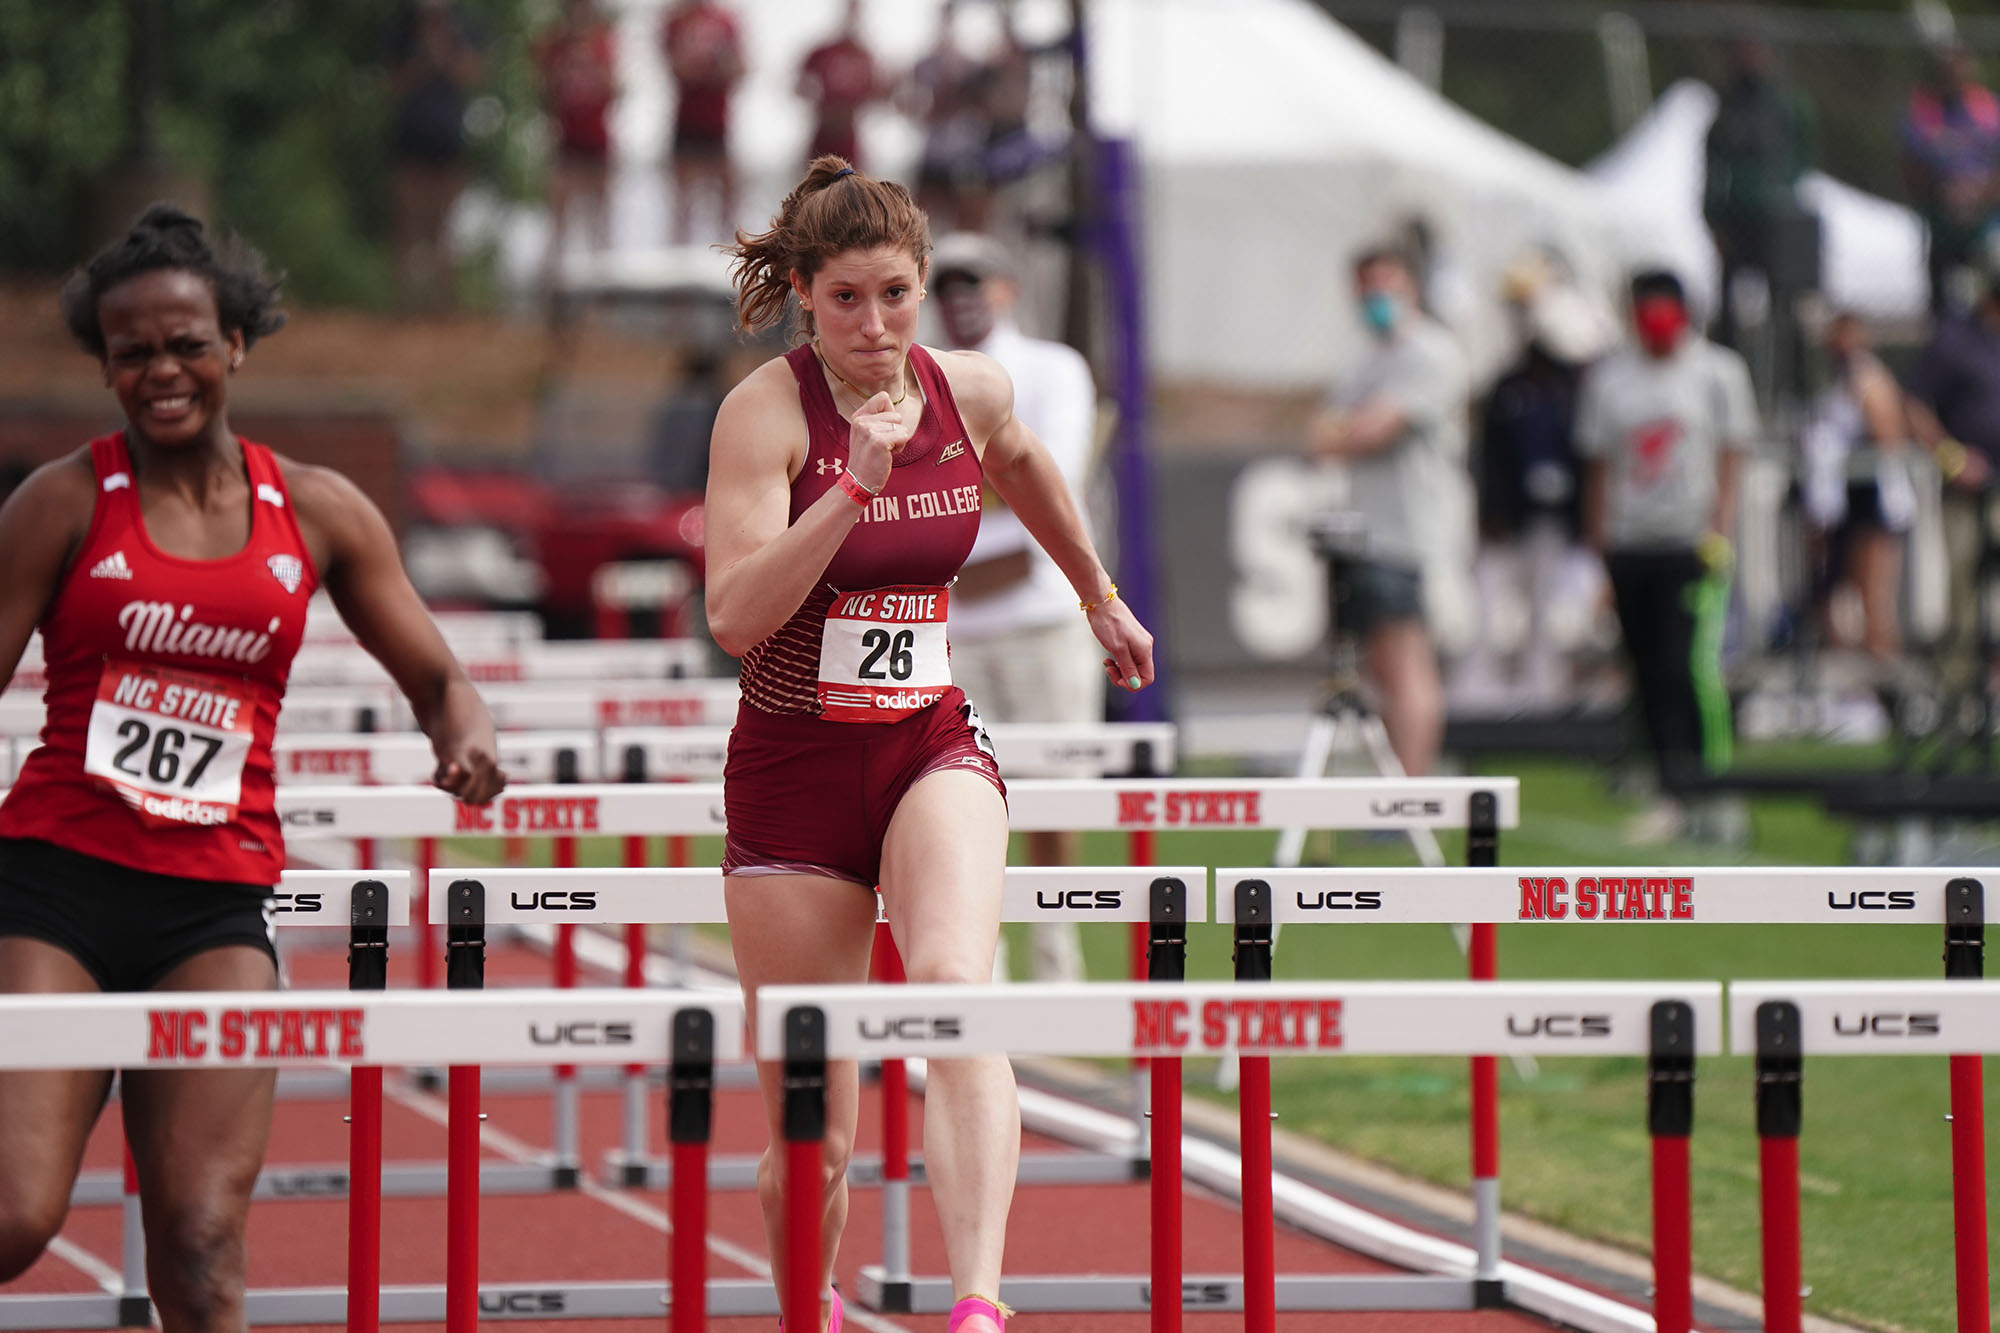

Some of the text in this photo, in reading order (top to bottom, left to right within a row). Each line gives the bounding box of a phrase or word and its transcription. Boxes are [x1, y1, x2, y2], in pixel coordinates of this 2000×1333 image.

[940, 440, 965, 460] ACC
[906, 485, 981, 519] COLLEGE
[840, 594, 937, 620] NC STATE
[118, 600, 281, 664] Miami
[858, 628, 914, 681] 26
[114, 673, 159, 709] NC
[158, 683, 241, 730] STATE
[112, 718, 224, 788] 267
[502, 797, 599, 831] STATE
[1117, 790, 1443, 825] NC STATE UCS
[511, 892, 595, 910] UCS
[1037, 891, 1121, 909] UCS
[1297, 877, 1915, 919] UCS NC STATE UCS
[148, 1009, 633, 1060] NC STATE UCS
[858, 1000, 1611, 1048] UCS NC STATE UCS
[1834, 1013, 1940, 1035] UCS
[480, 1294, 564, 1312] UCS
